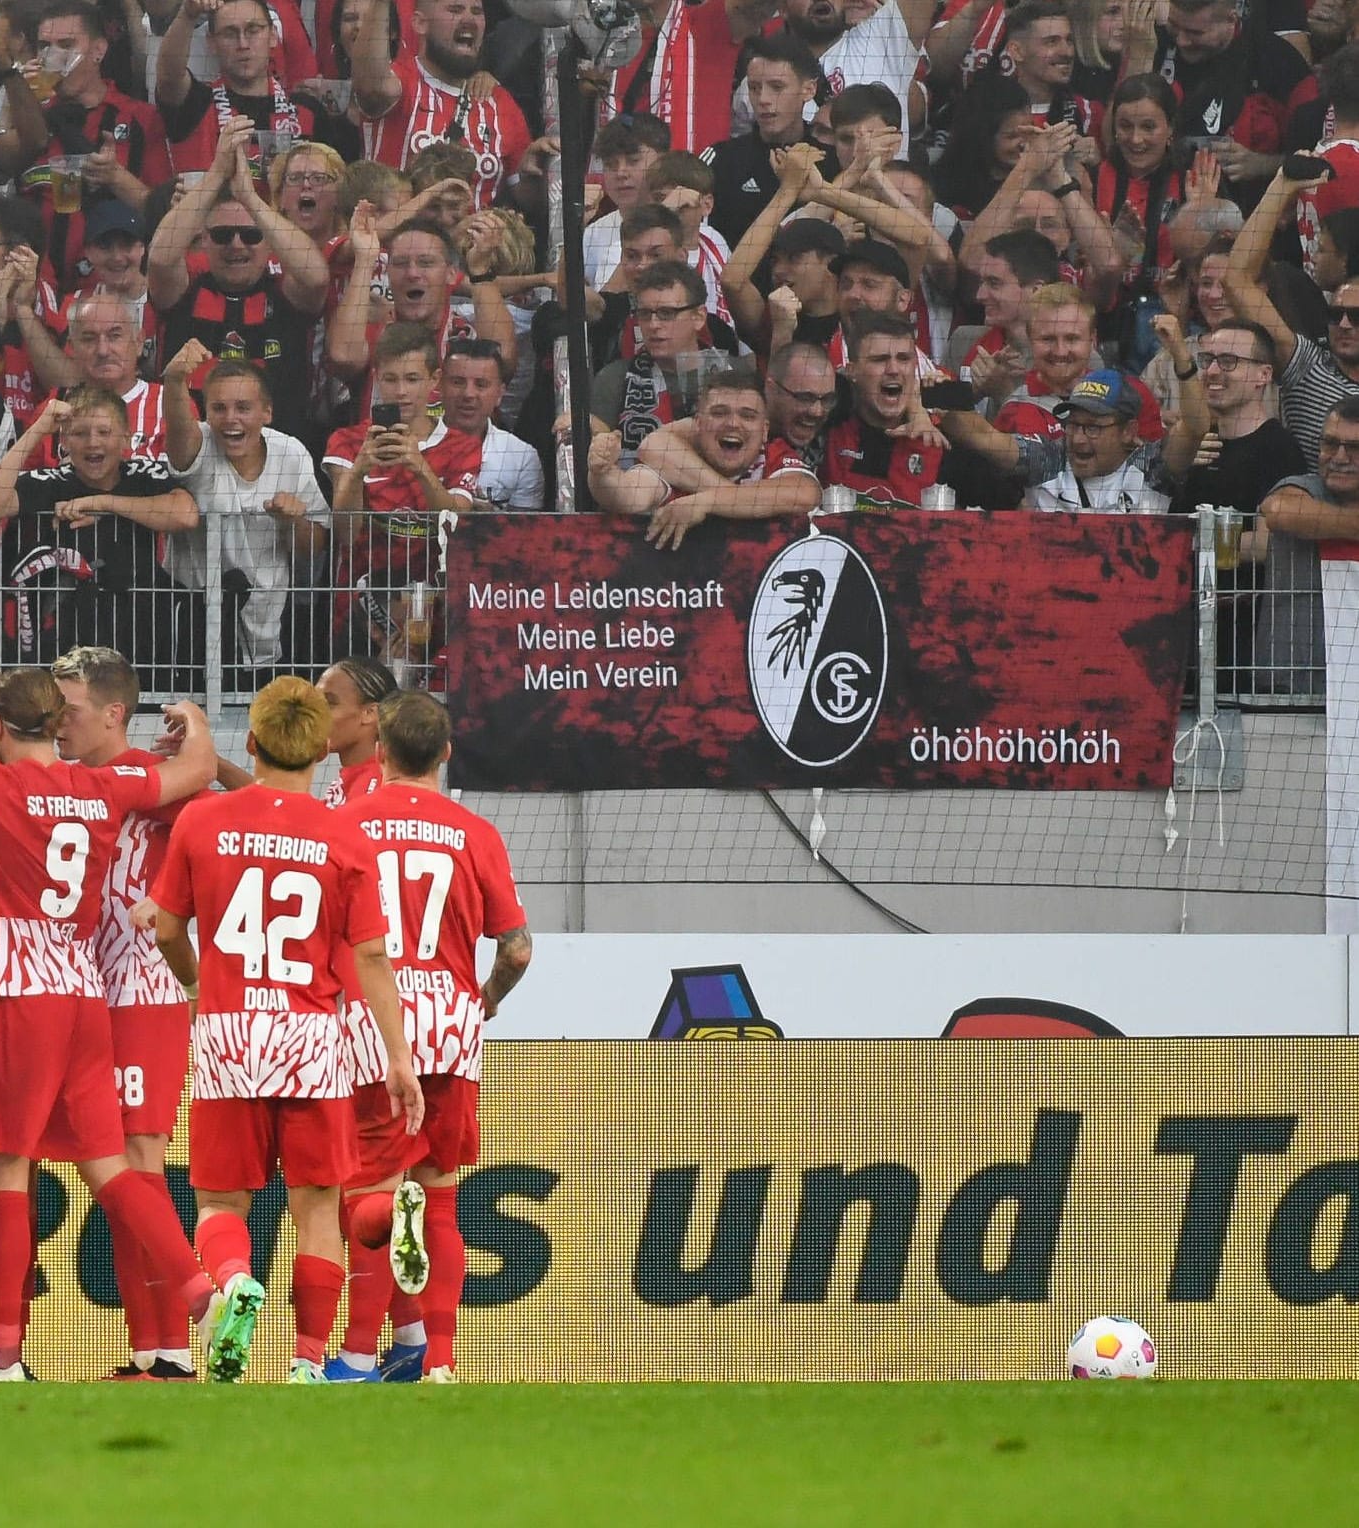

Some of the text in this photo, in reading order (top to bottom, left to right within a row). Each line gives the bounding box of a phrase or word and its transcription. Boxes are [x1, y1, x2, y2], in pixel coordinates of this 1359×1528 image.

[469, 580, 724, 609] Meine Leidenschaft
[517, 620, 675, 650] Meine Liebe
[524, 661, 677, 690] Mein Verein
[910, 726, 1120, 764] öhöhöhöhöh
[27, 795, 45, 816] SC
[217, 831, 329, 866] SC FREIBURG
[360, 819, 466, 851] SC FREIBURG
[40, 822, 89, 918] 9
[377, 850, 454, 961] 17
[213, 867, 322, 985] 42
[243, 986, 290, 1012] DOAN
[633, 1109, 1083, 1308] und
